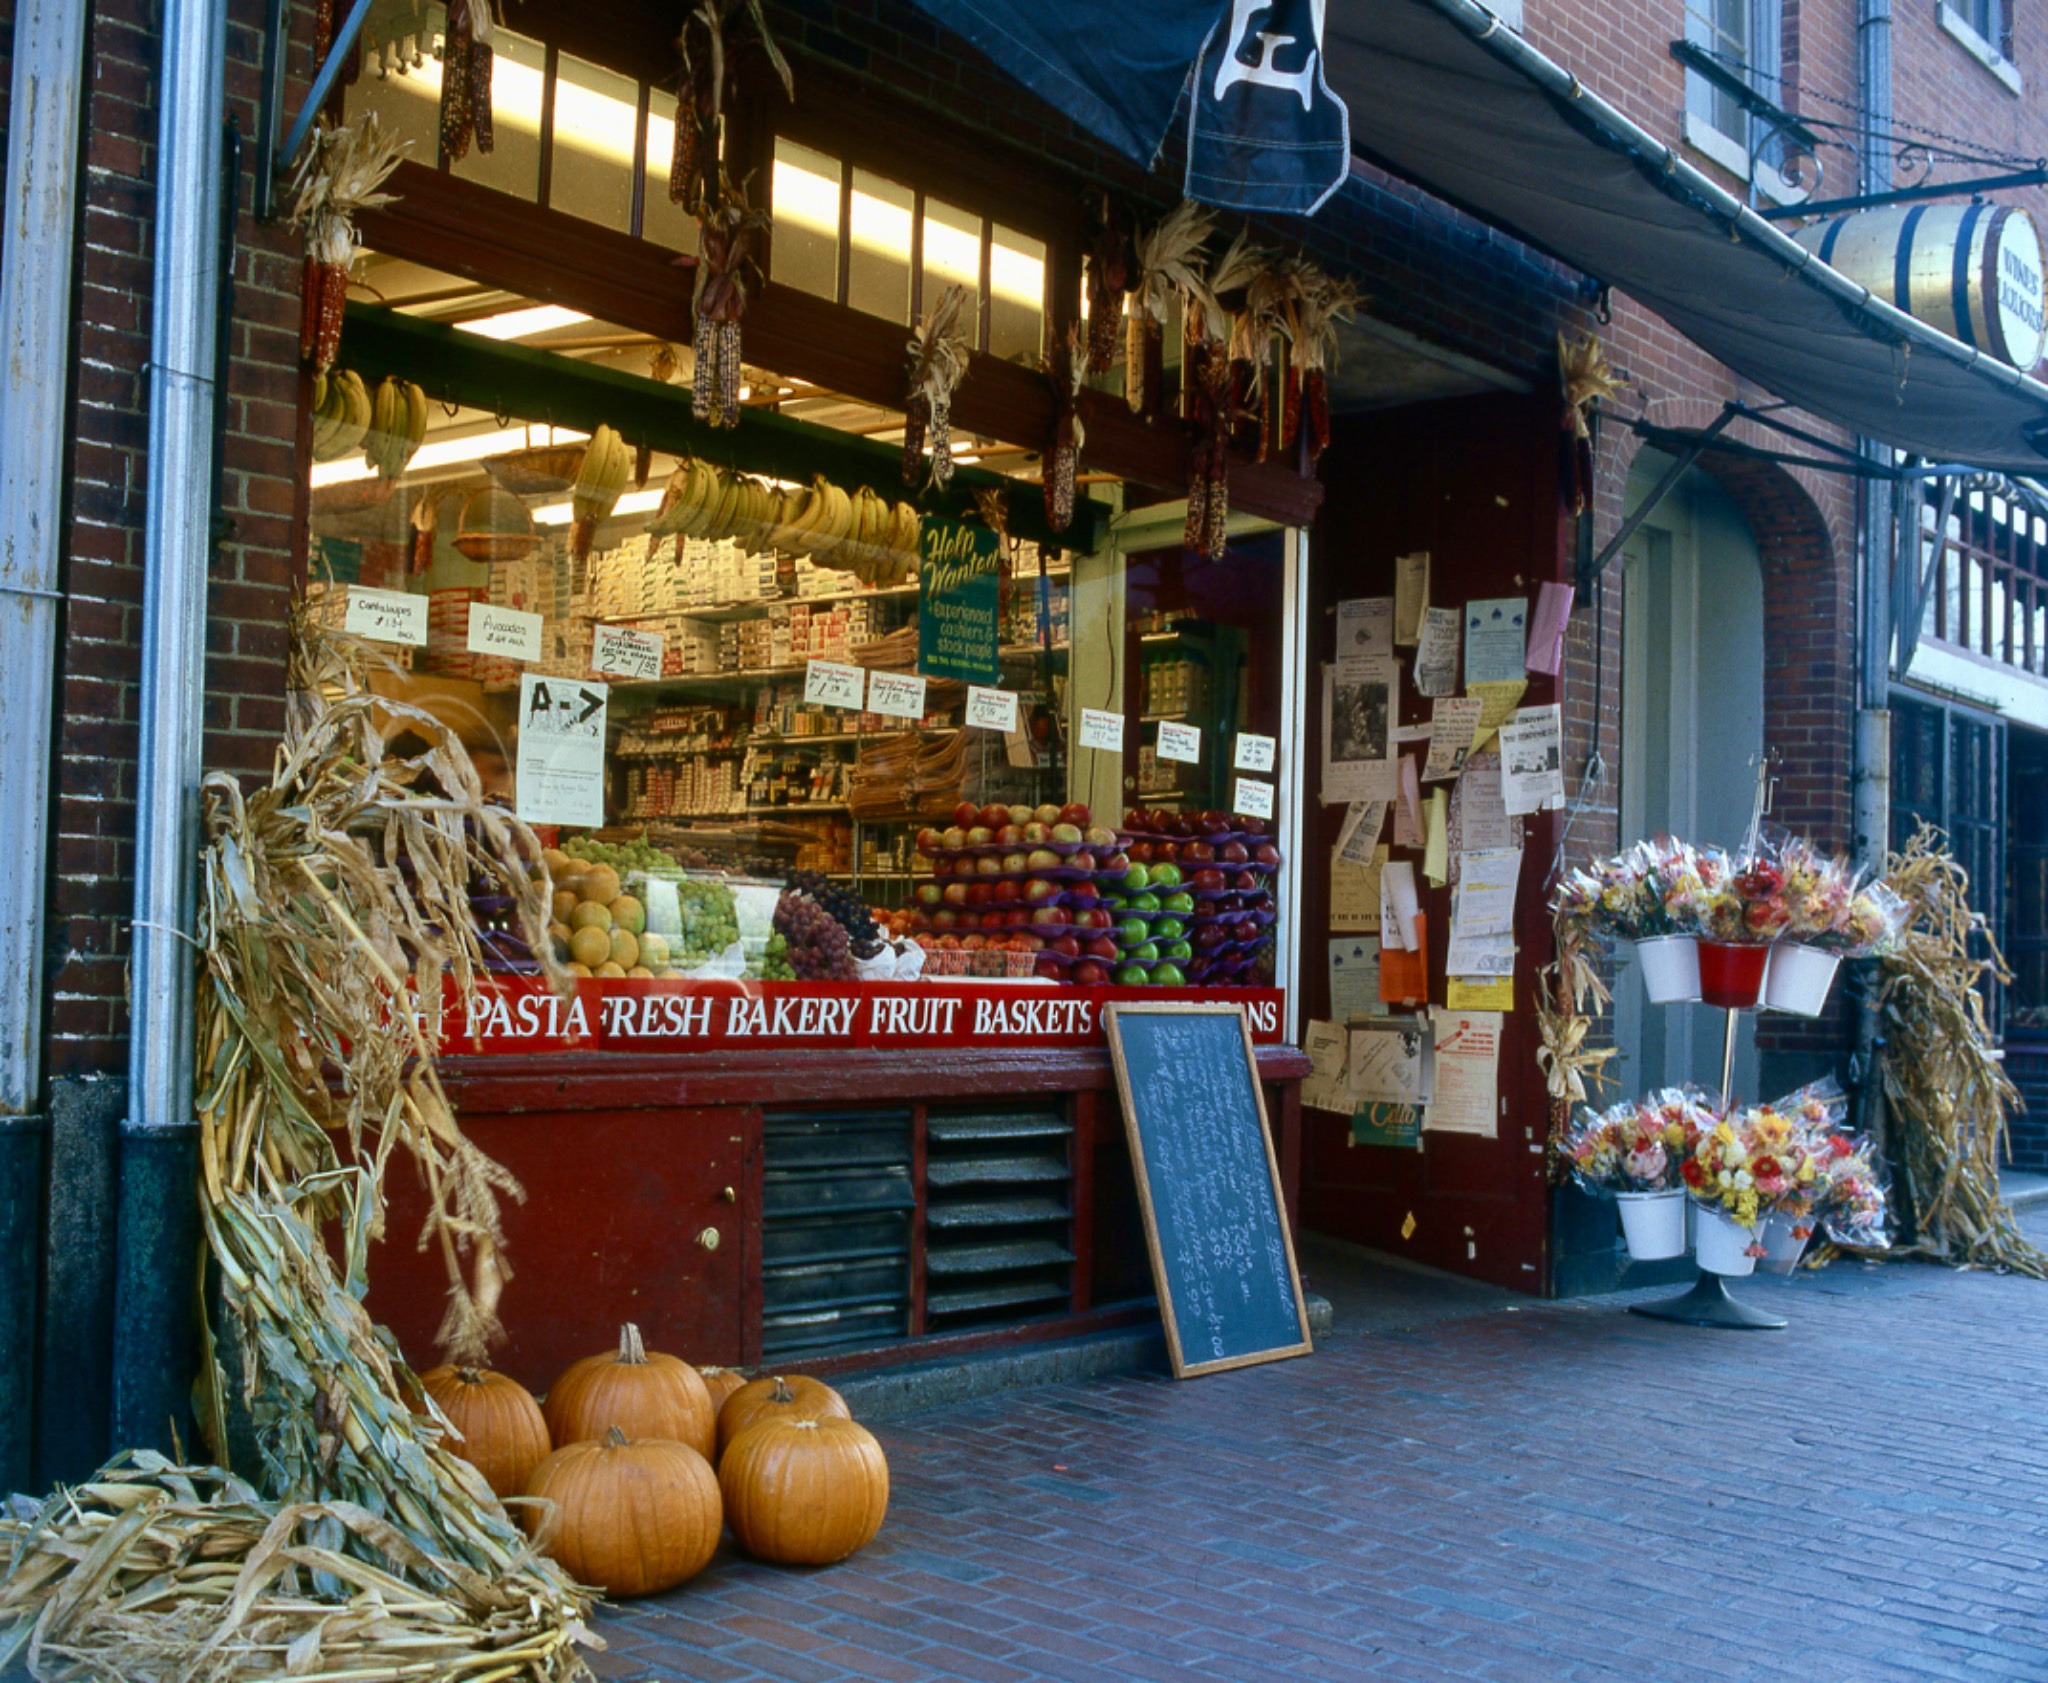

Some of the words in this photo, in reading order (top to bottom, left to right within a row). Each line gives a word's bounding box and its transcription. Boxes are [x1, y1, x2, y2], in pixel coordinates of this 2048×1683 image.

[927, 525, 976, 562] Help
[924, 549, 999, 600] Wanted
[483, 613, 527, 635] Avocados
[934, 600, 993, 624] Experienced
[463, 994, 592, 1037] PASTA
[726, 997, 860, 1036] BAKERY
[870, 997, 962, 1035] FRUIT
[973, 998, 1092, 1034] BASKETS
